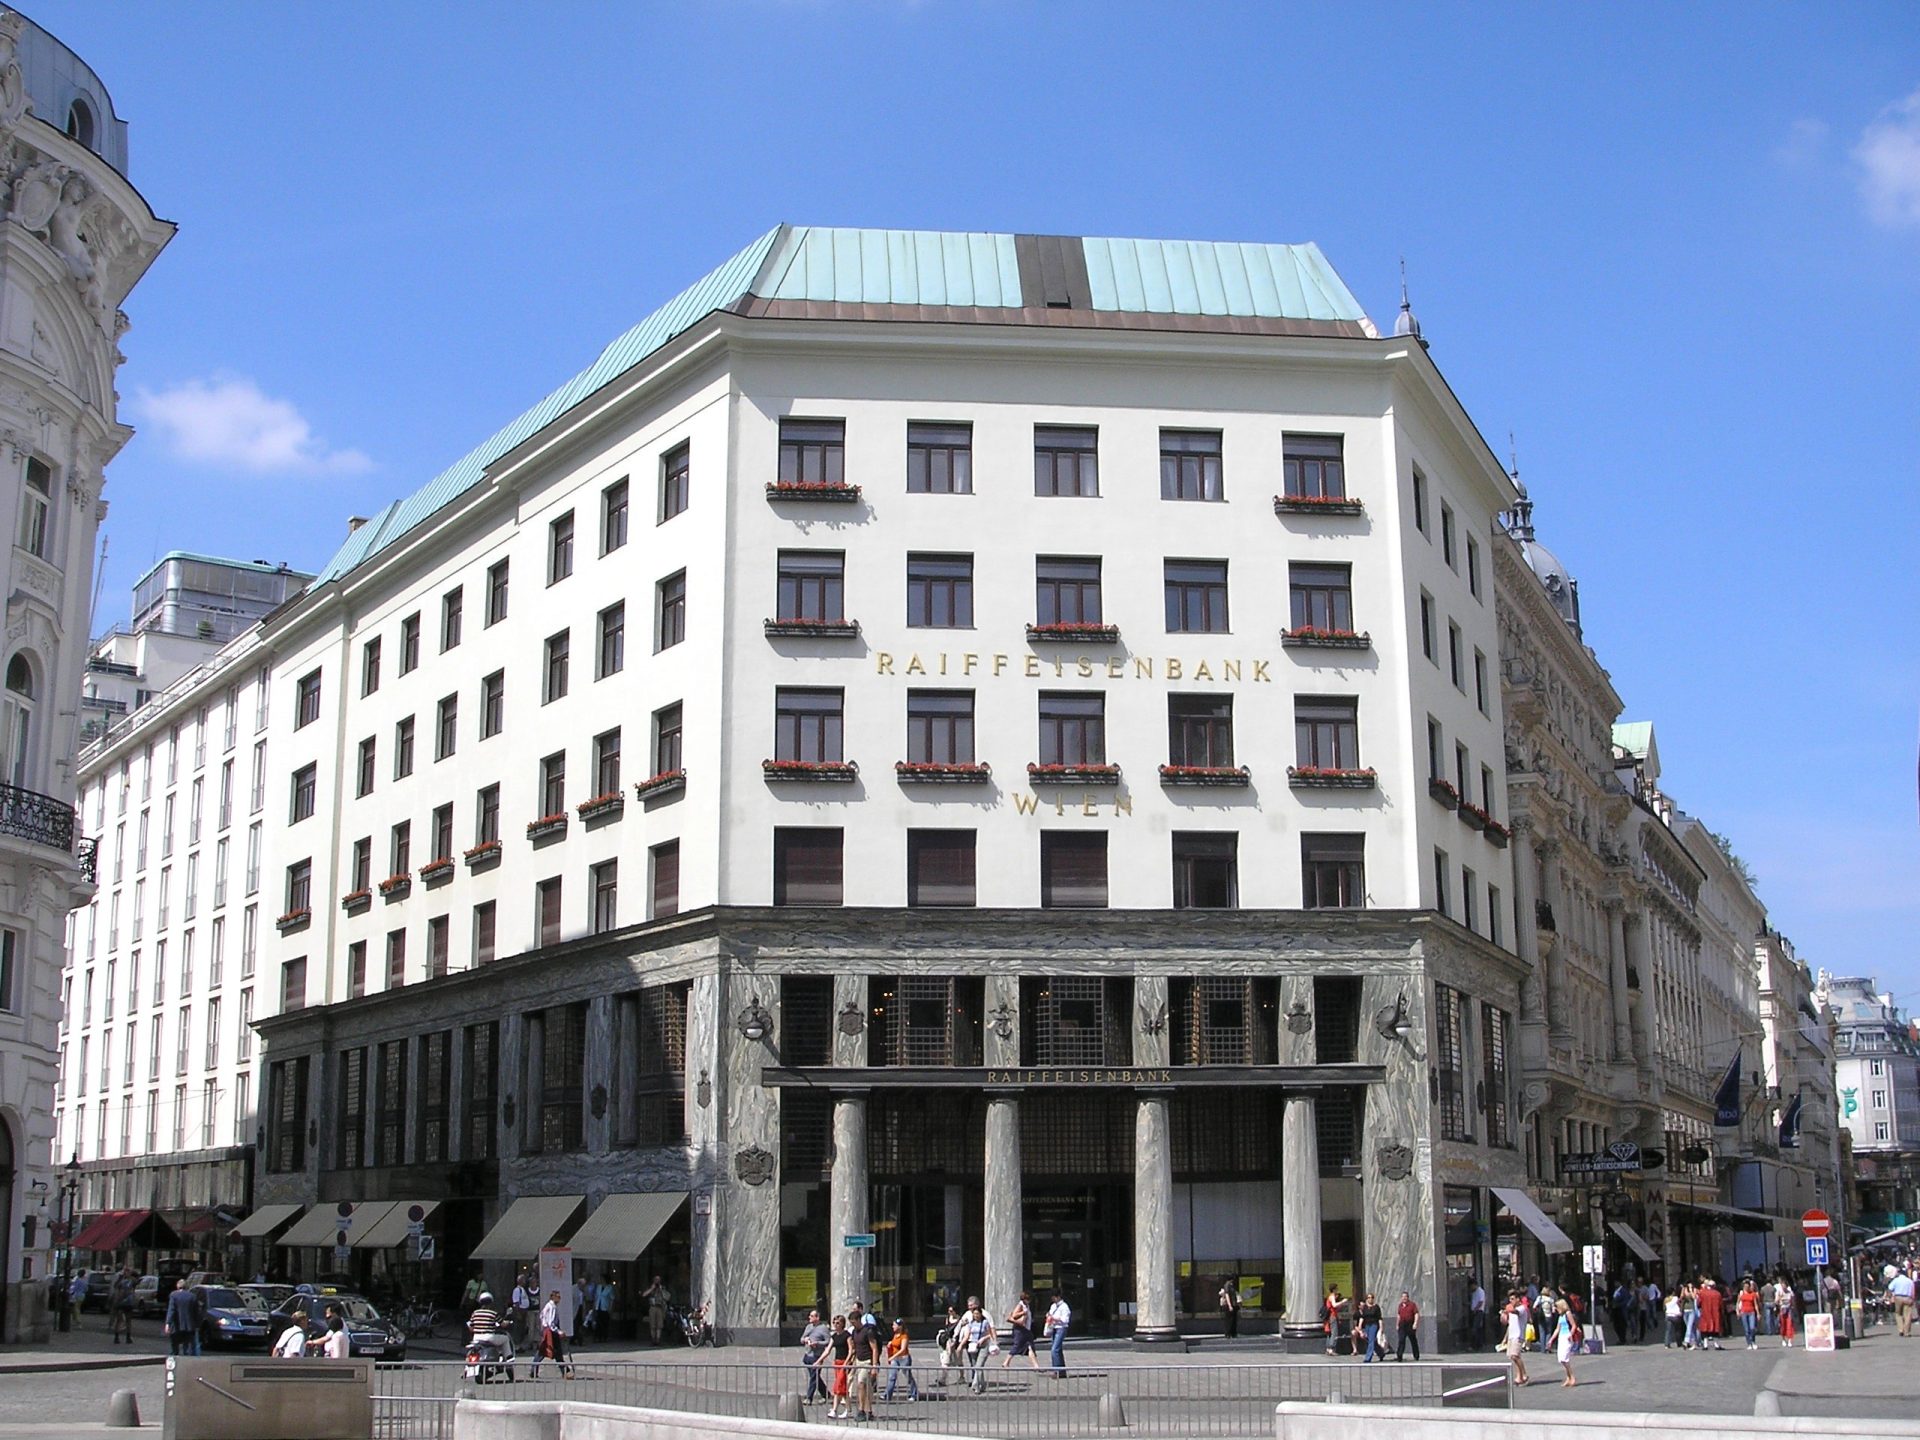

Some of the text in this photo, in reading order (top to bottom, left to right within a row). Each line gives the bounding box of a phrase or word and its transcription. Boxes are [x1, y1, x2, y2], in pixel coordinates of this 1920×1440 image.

[876, 651, 1272, 683] RAIFFEISENBANK
[1012, 792, 1134, 818] WIEN
[987, 1070, 1172, 1083] RAIFFEISENBANK
